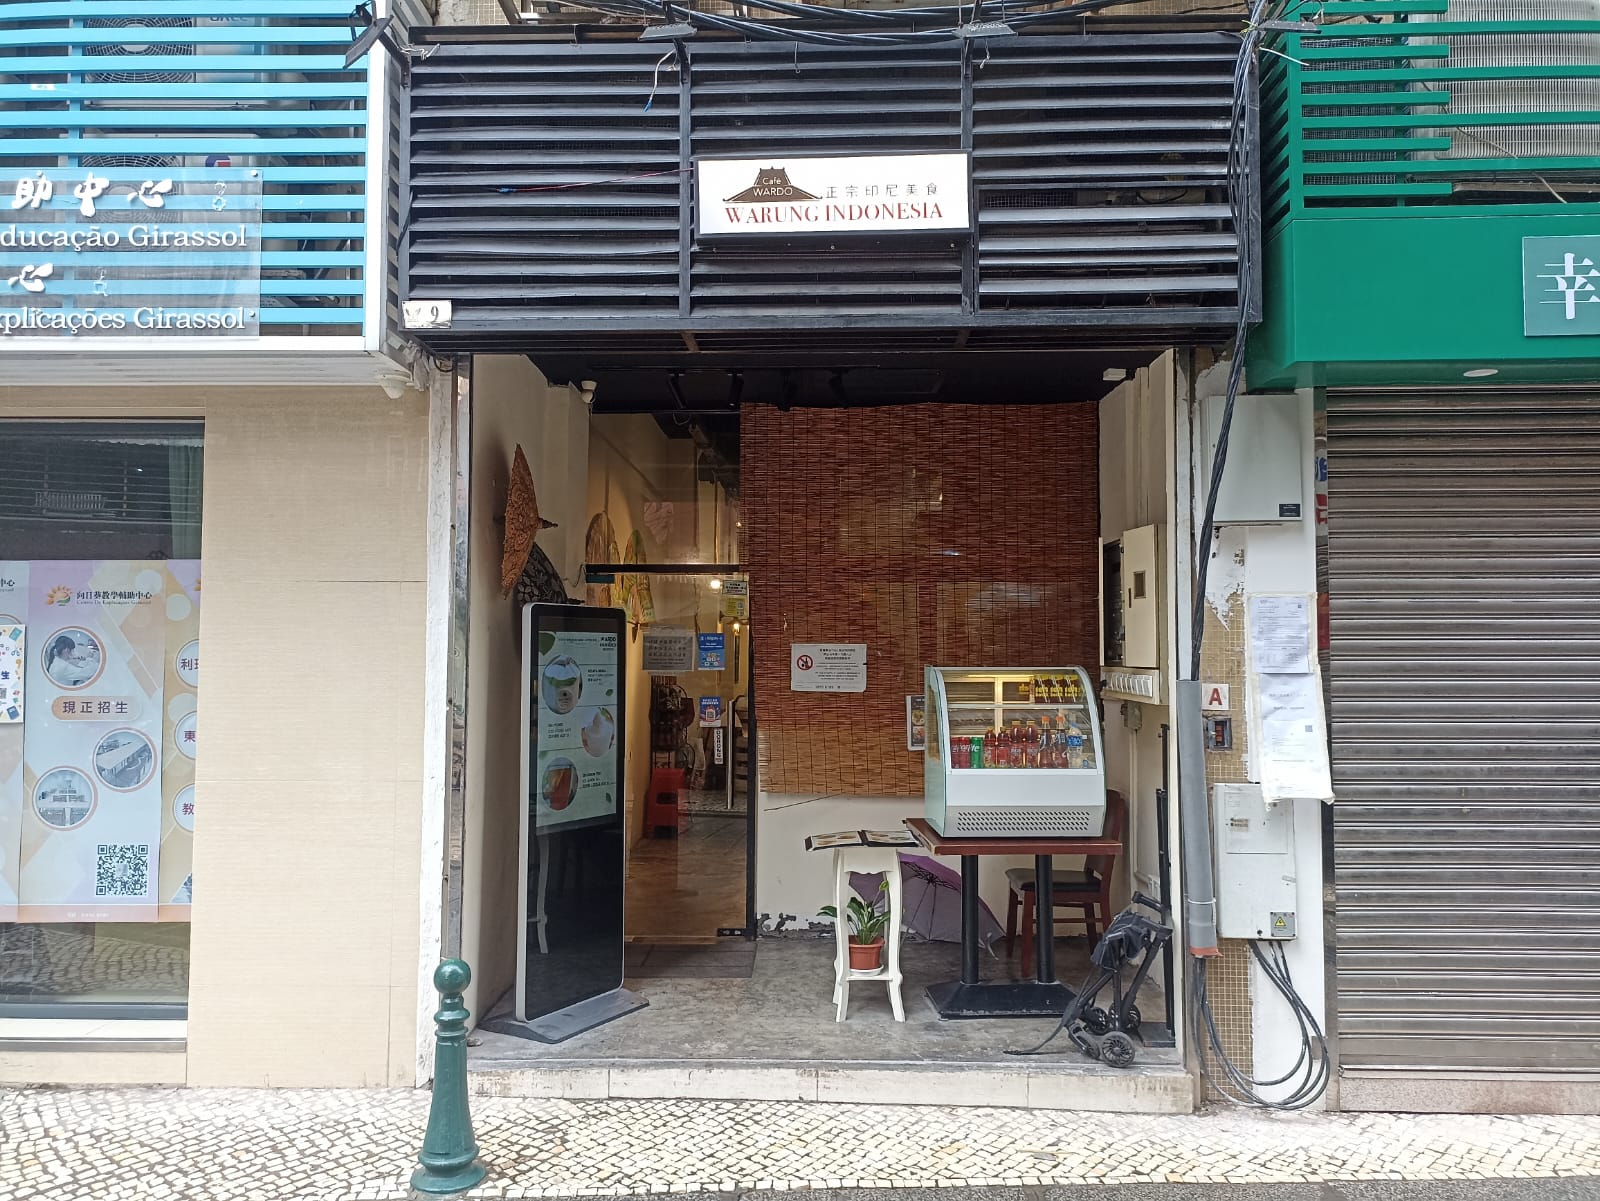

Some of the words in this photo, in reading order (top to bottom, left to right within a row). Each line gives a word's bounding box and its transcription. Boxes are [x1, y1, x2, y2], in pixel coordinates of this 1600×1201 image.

[762, 176, 782, 185] Café
[12, 171, 174, 217] 助中心
[752, 187, 793, 197] WARDO
[826, 182, 939, 199] 正宗印尼美食
[725, 205, 819, 224] WARUNG
[826, 202, 943, 221] INDONESIA
[128, 224, 247, 248] Girassol
[8, 263, 54, 292] 心
[1536, 252, 1600, 320] 幸
[133, 307, 245, 330] Girassol
[76, 591, 153, 600] 向日葵教學輔助中心
[1208, 688, 1223, 706] A
[62, 701, 129, 714] 現正招生
[183, 730, 196, 743] 東
[182, 803, 194, 815] 教
